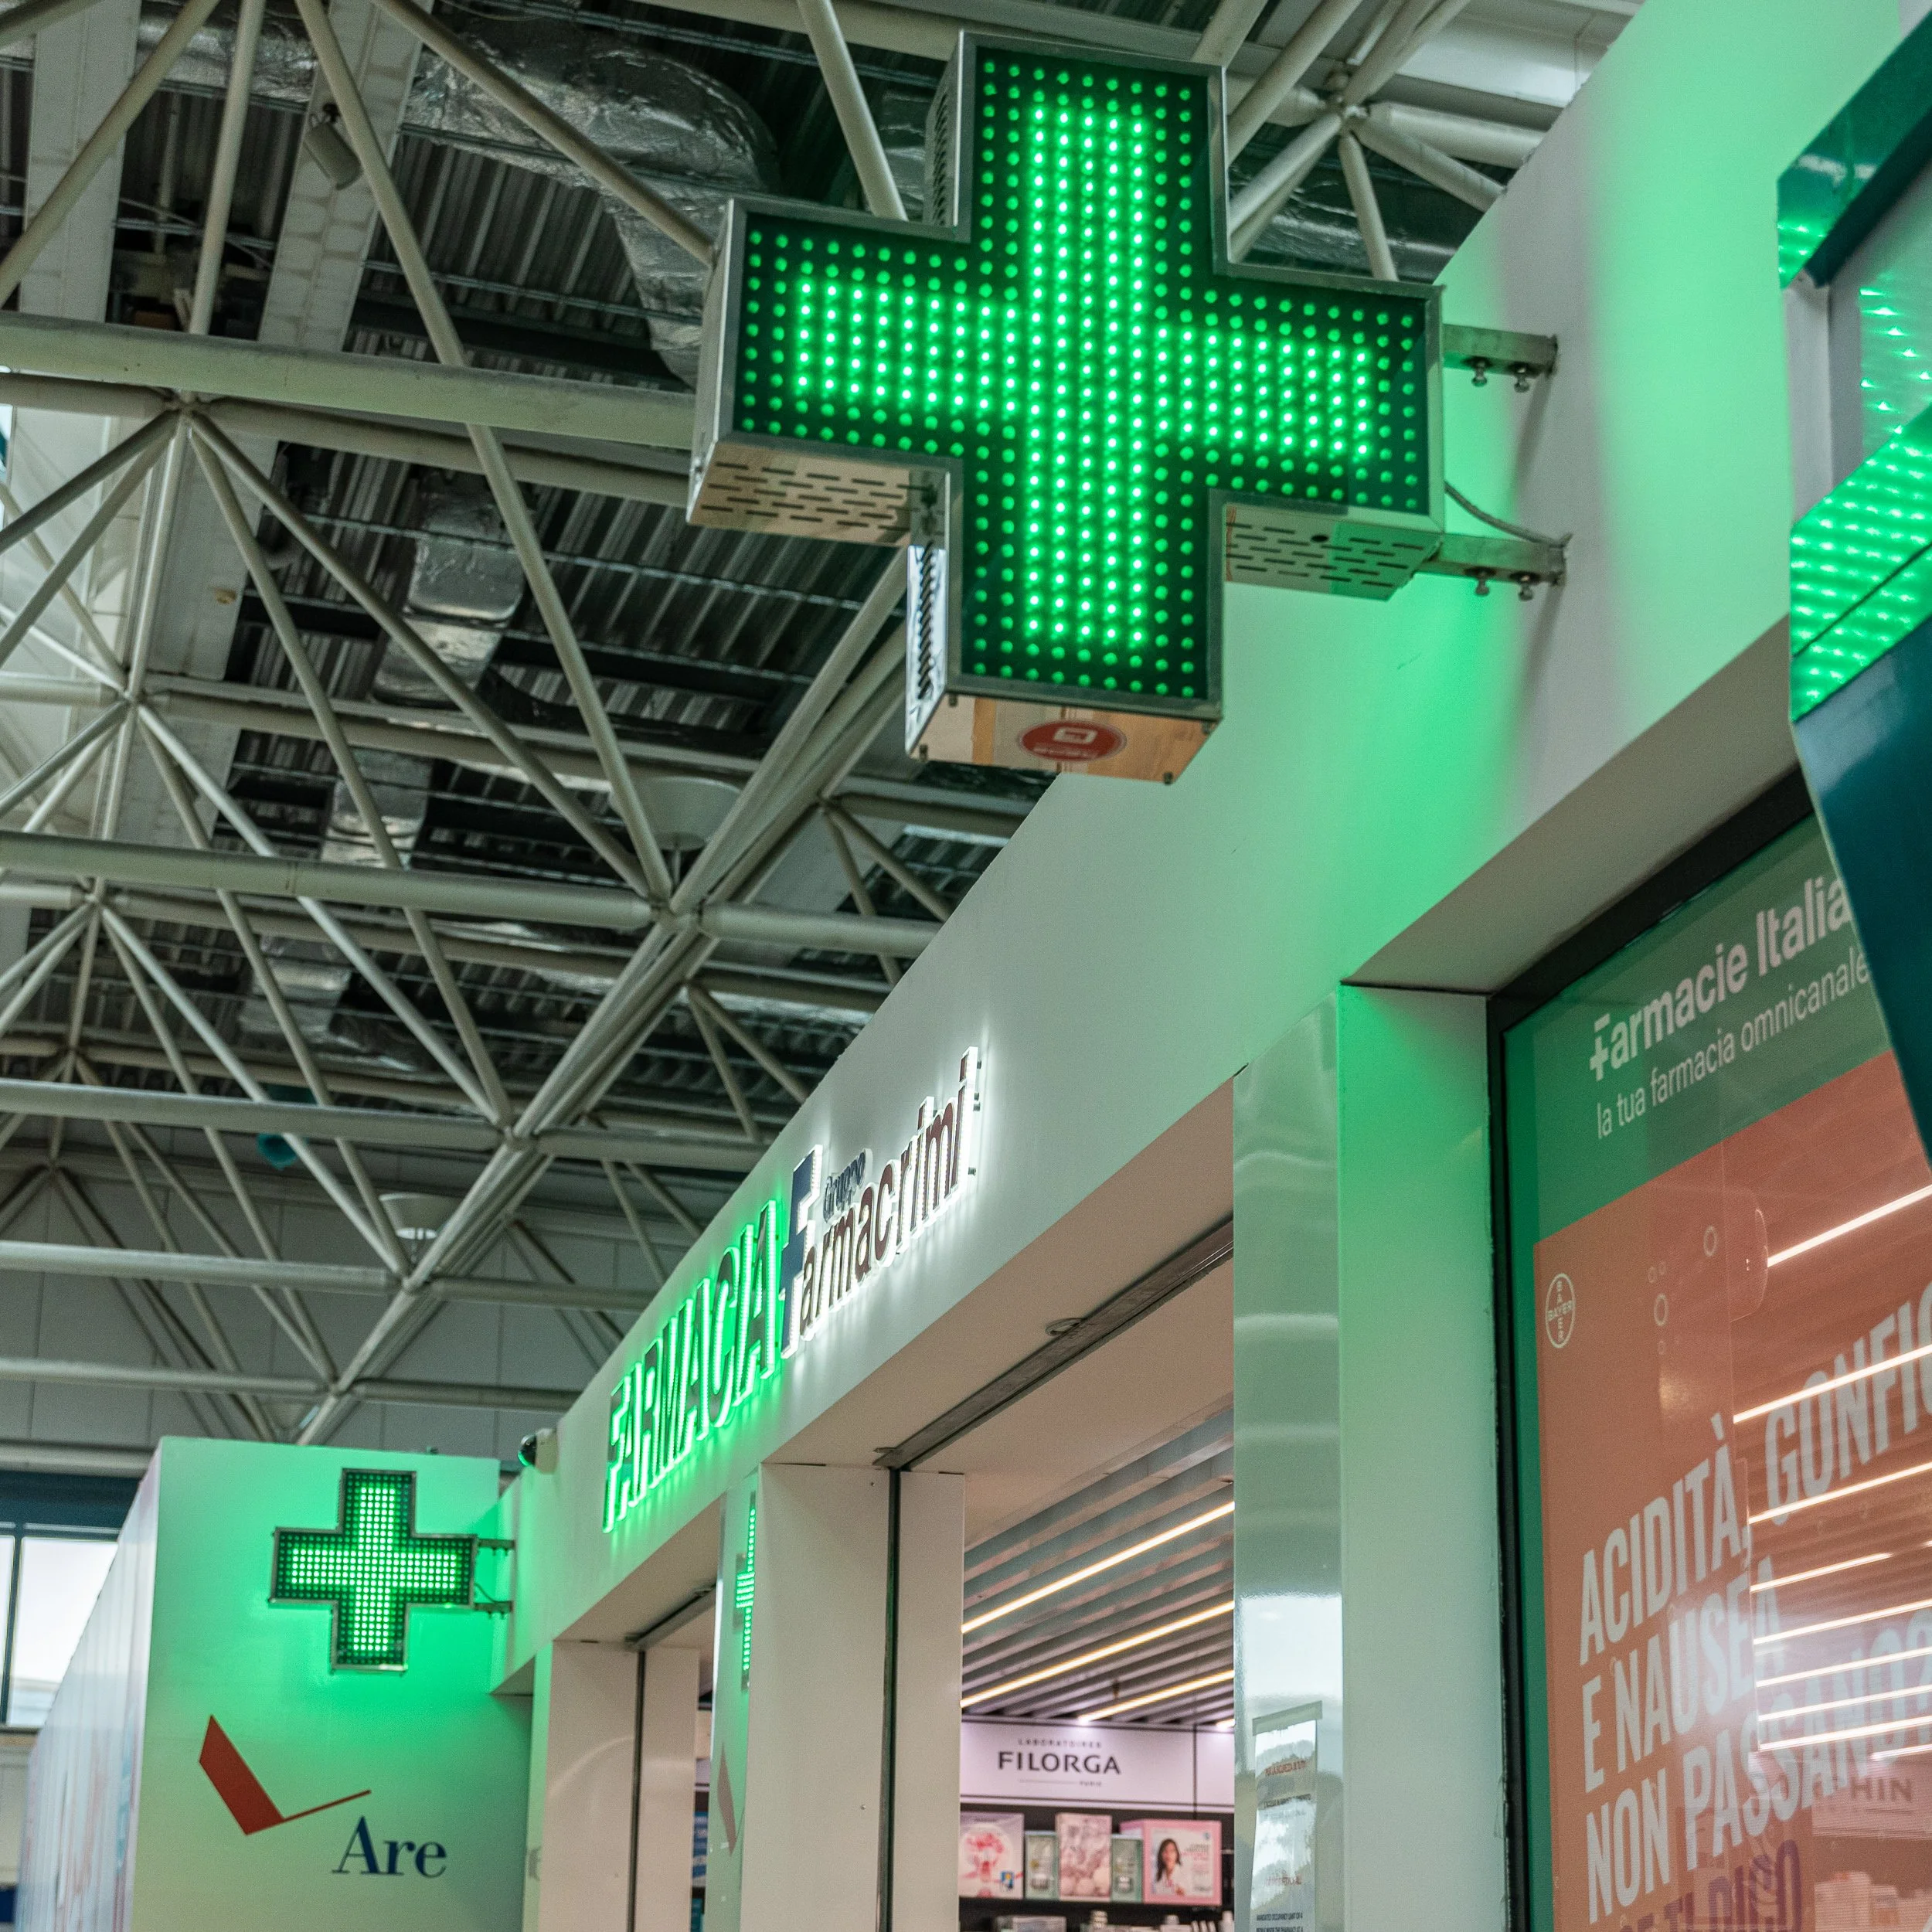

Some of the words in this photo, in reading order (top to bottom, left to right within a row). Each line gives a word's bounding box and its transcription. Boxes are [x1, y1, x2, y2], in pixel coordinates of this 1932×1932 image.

[1597, 1102, 1613, 1139] la
[1617, 1085, 1646, 1126] tua
[1650, 1029, 1736, 1106] farmacia
[1740, 947, 1869, 1053] omnicanale
[1580, 1413, 1753, 1666] ACIDITÀ,
[1582, 1676, 1604, 1793] E
[1615, 1556, 1784, 1773] NAUSEA
[332, 1815, 447, 1879] Are
[998, 1750, 1121, 1775] FILORGA
[1586, 1769, 1670, 1924] NON
